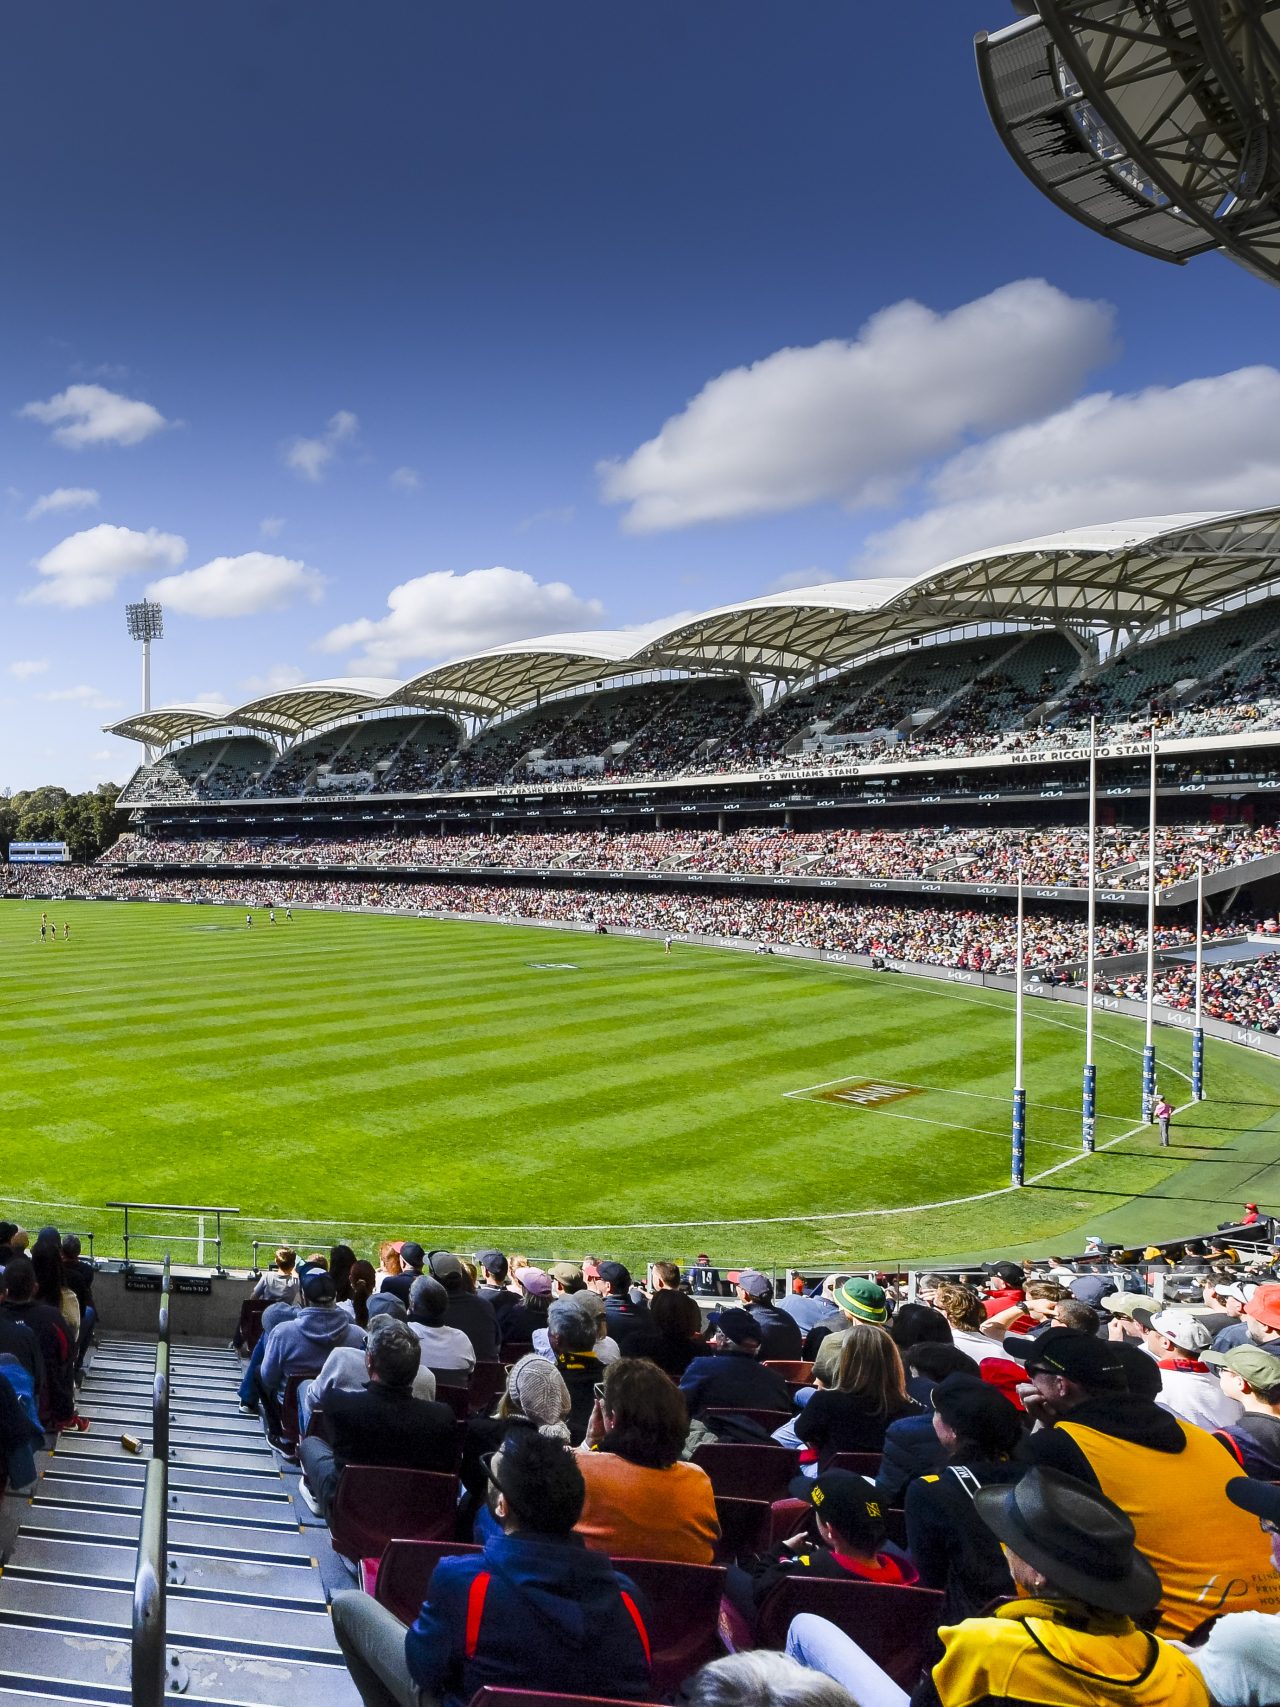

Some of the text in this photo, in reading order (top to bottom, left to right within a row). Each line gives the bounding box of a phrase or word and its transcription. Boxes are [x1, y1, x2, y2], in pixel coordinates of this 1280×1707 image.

[1011, 753, 1046, 763] MARK
[780, 769, 824, 778] WILLIAMS
[828, 768, 859, 776] STAND
